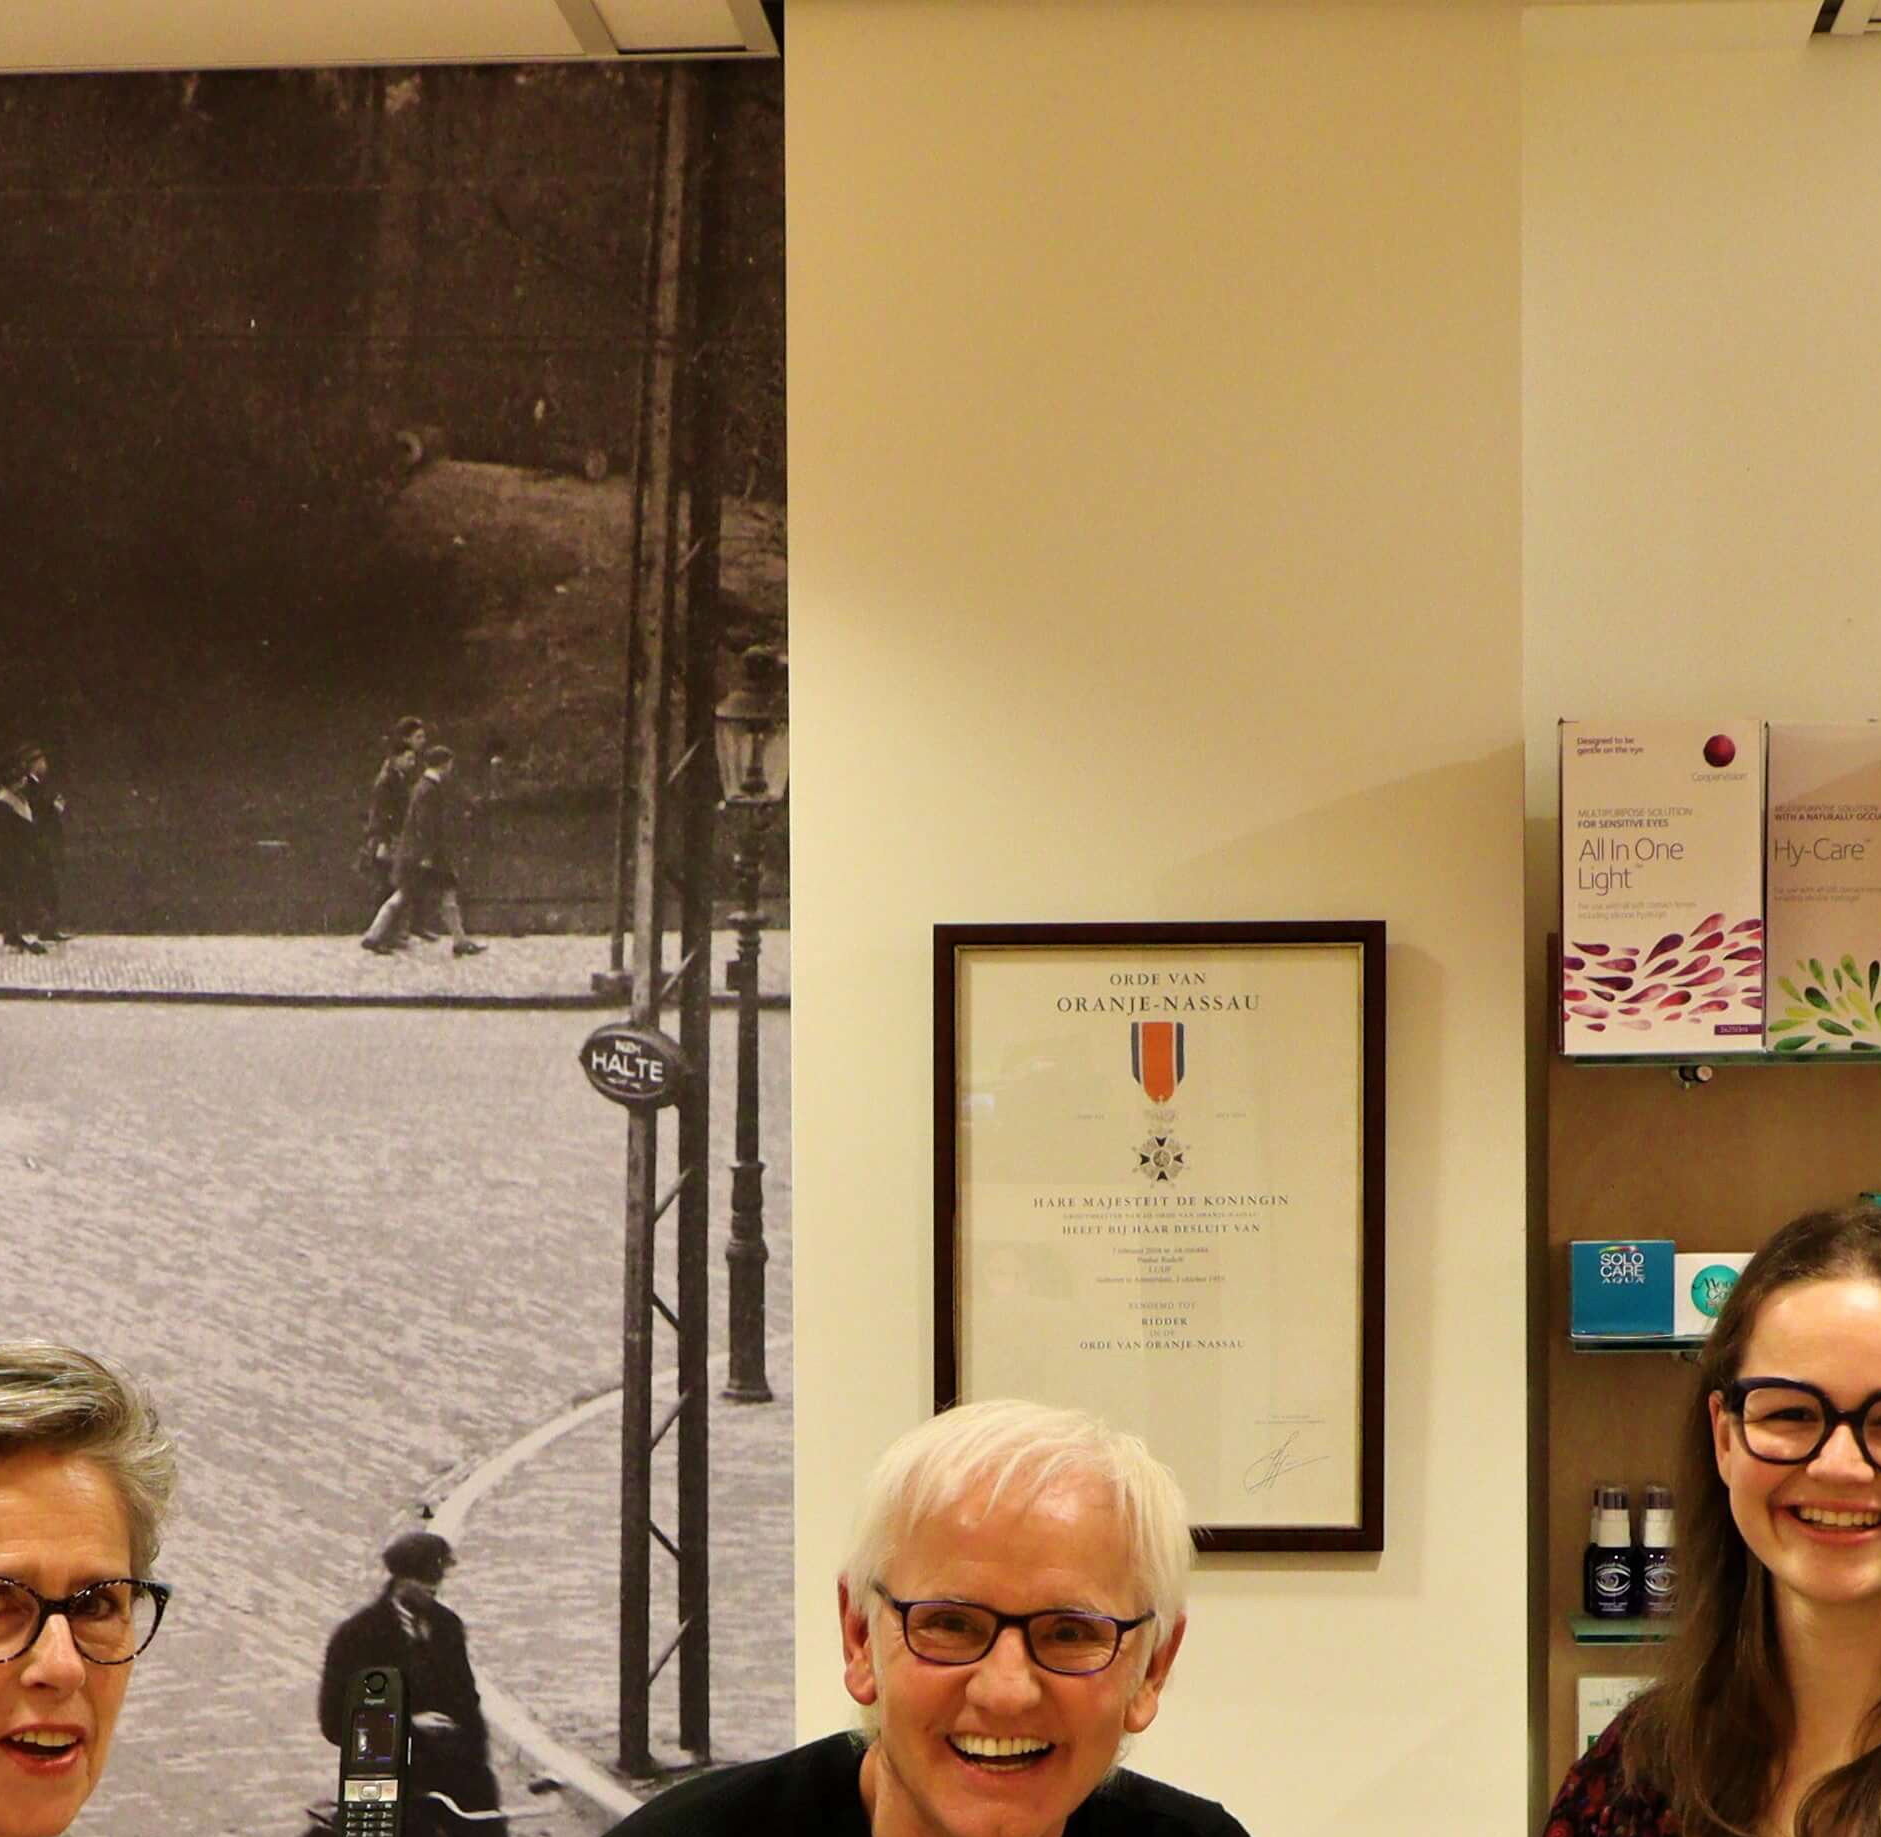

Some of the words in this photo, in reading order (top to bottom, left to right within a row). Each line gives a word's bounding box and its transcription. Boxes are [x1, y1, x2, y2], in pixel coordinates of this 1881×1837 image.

[1578, 820, 1596, 829] FOR
[1599, 819, 1643, 829] SENSITIVE
[1646, 818, 1668, 828] EYES
[1579, 838, 1604, 861] All
[1611, 838, 1629, 861] In
[1635, 838, 1684, 861] One
[1773, 838, 1865, 867] Hy-Care
[1578, 866, 1633, 896] Light
[1109, 973, 1159, 986] ORDE
[1169, 972, 1207, 984] VAN
[1056, 994, 1262, 1016] ORANJE-NASSAU
[591, 1050, 663, 1082] HALTE
[1033, 1197, 1077, 1208] HARE
[1082, 1196, 1169, 1209] MAJESTEIT
[1177, 1195, 1197, 1206] DE
[1203, 1195, 1289, 1206] KONINGIN
[1600, 1252, 1644, 1266] SOLO
[1600, 1265, 1644, 1278] CARE
[1142, 1317, 1188, 1326] RIDDER
